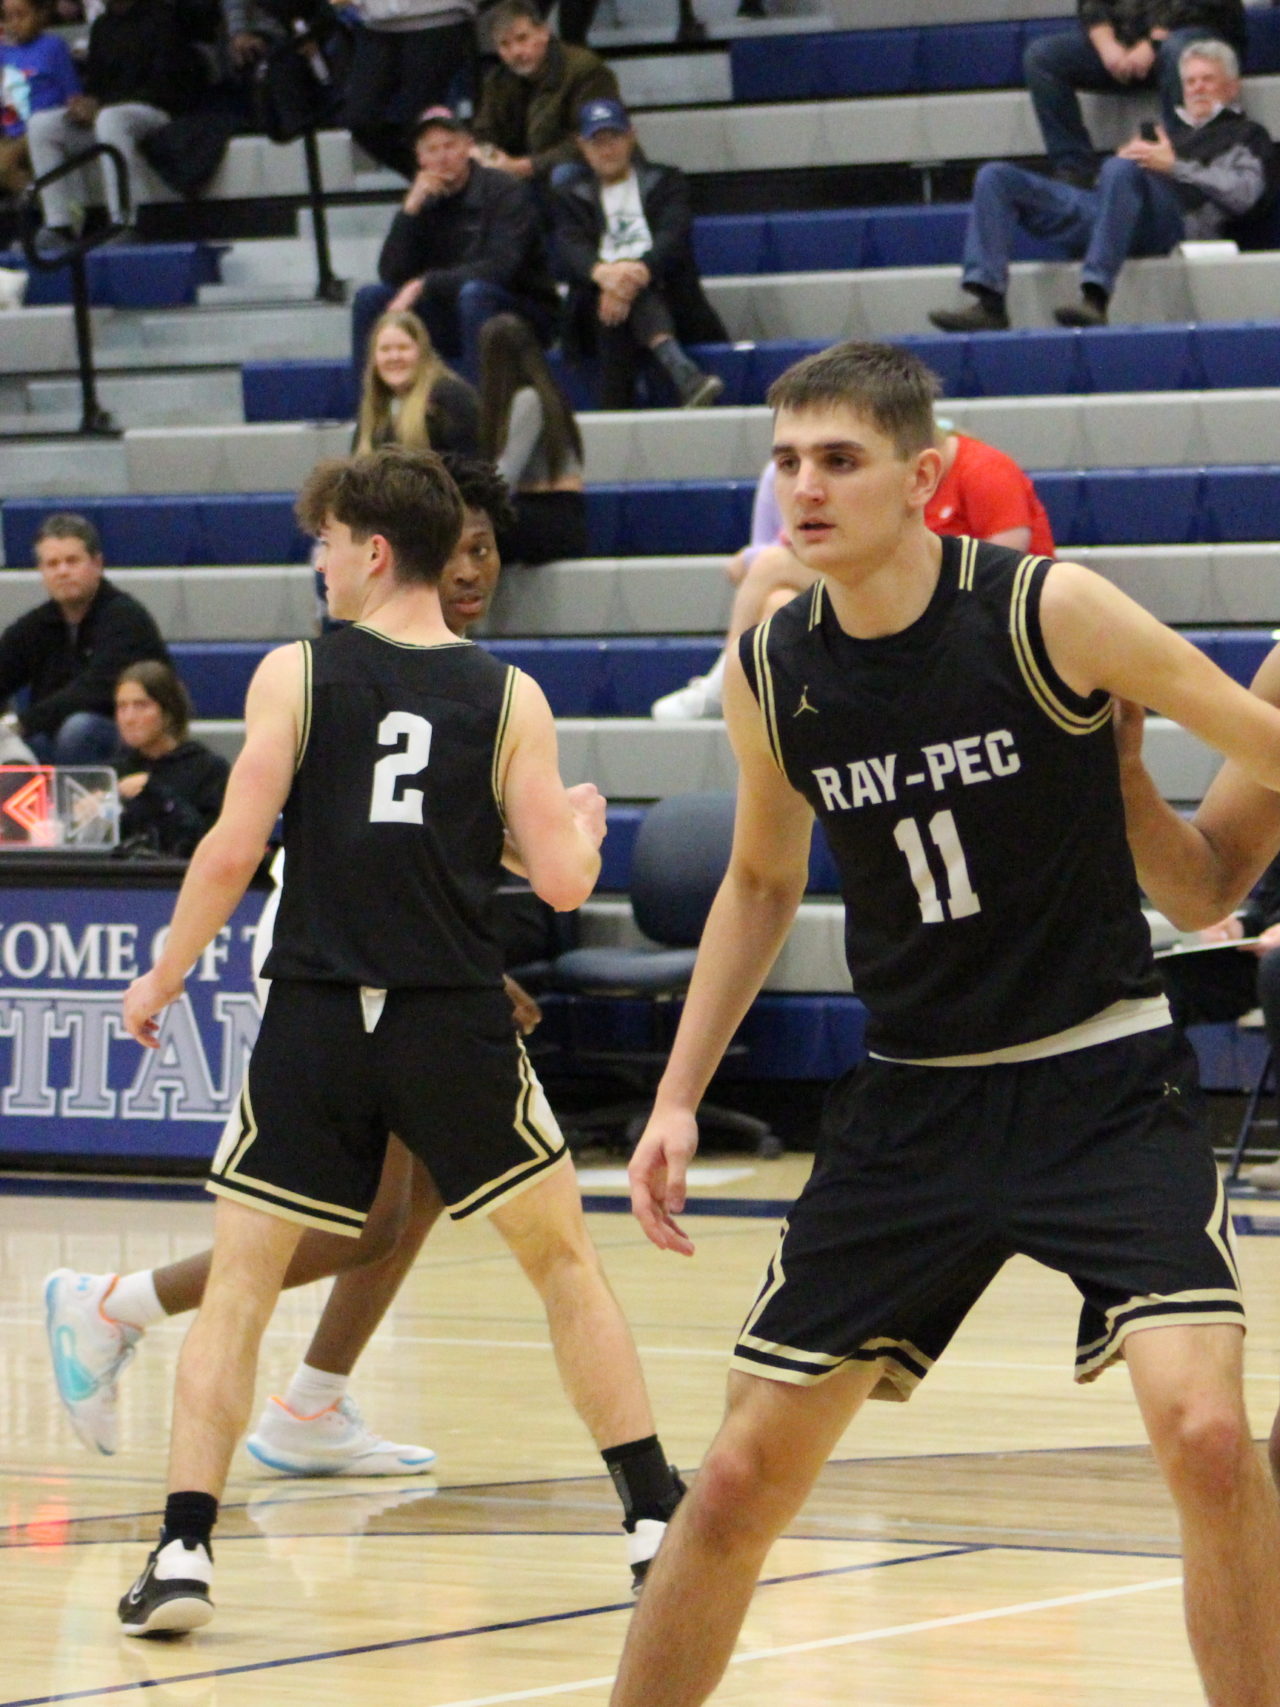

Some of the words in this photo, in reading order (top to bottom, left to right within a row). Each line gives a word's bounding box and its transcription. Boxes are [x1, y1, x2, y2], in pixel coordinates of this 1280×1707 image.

[370, 711, 432, 825] 2
[811, 729, 1021, 811] RAY-PEC
[893, 809, 981, 924] 11
[0, 922, 139, 980] OME
[0, 988, 262, 1122] ITA
